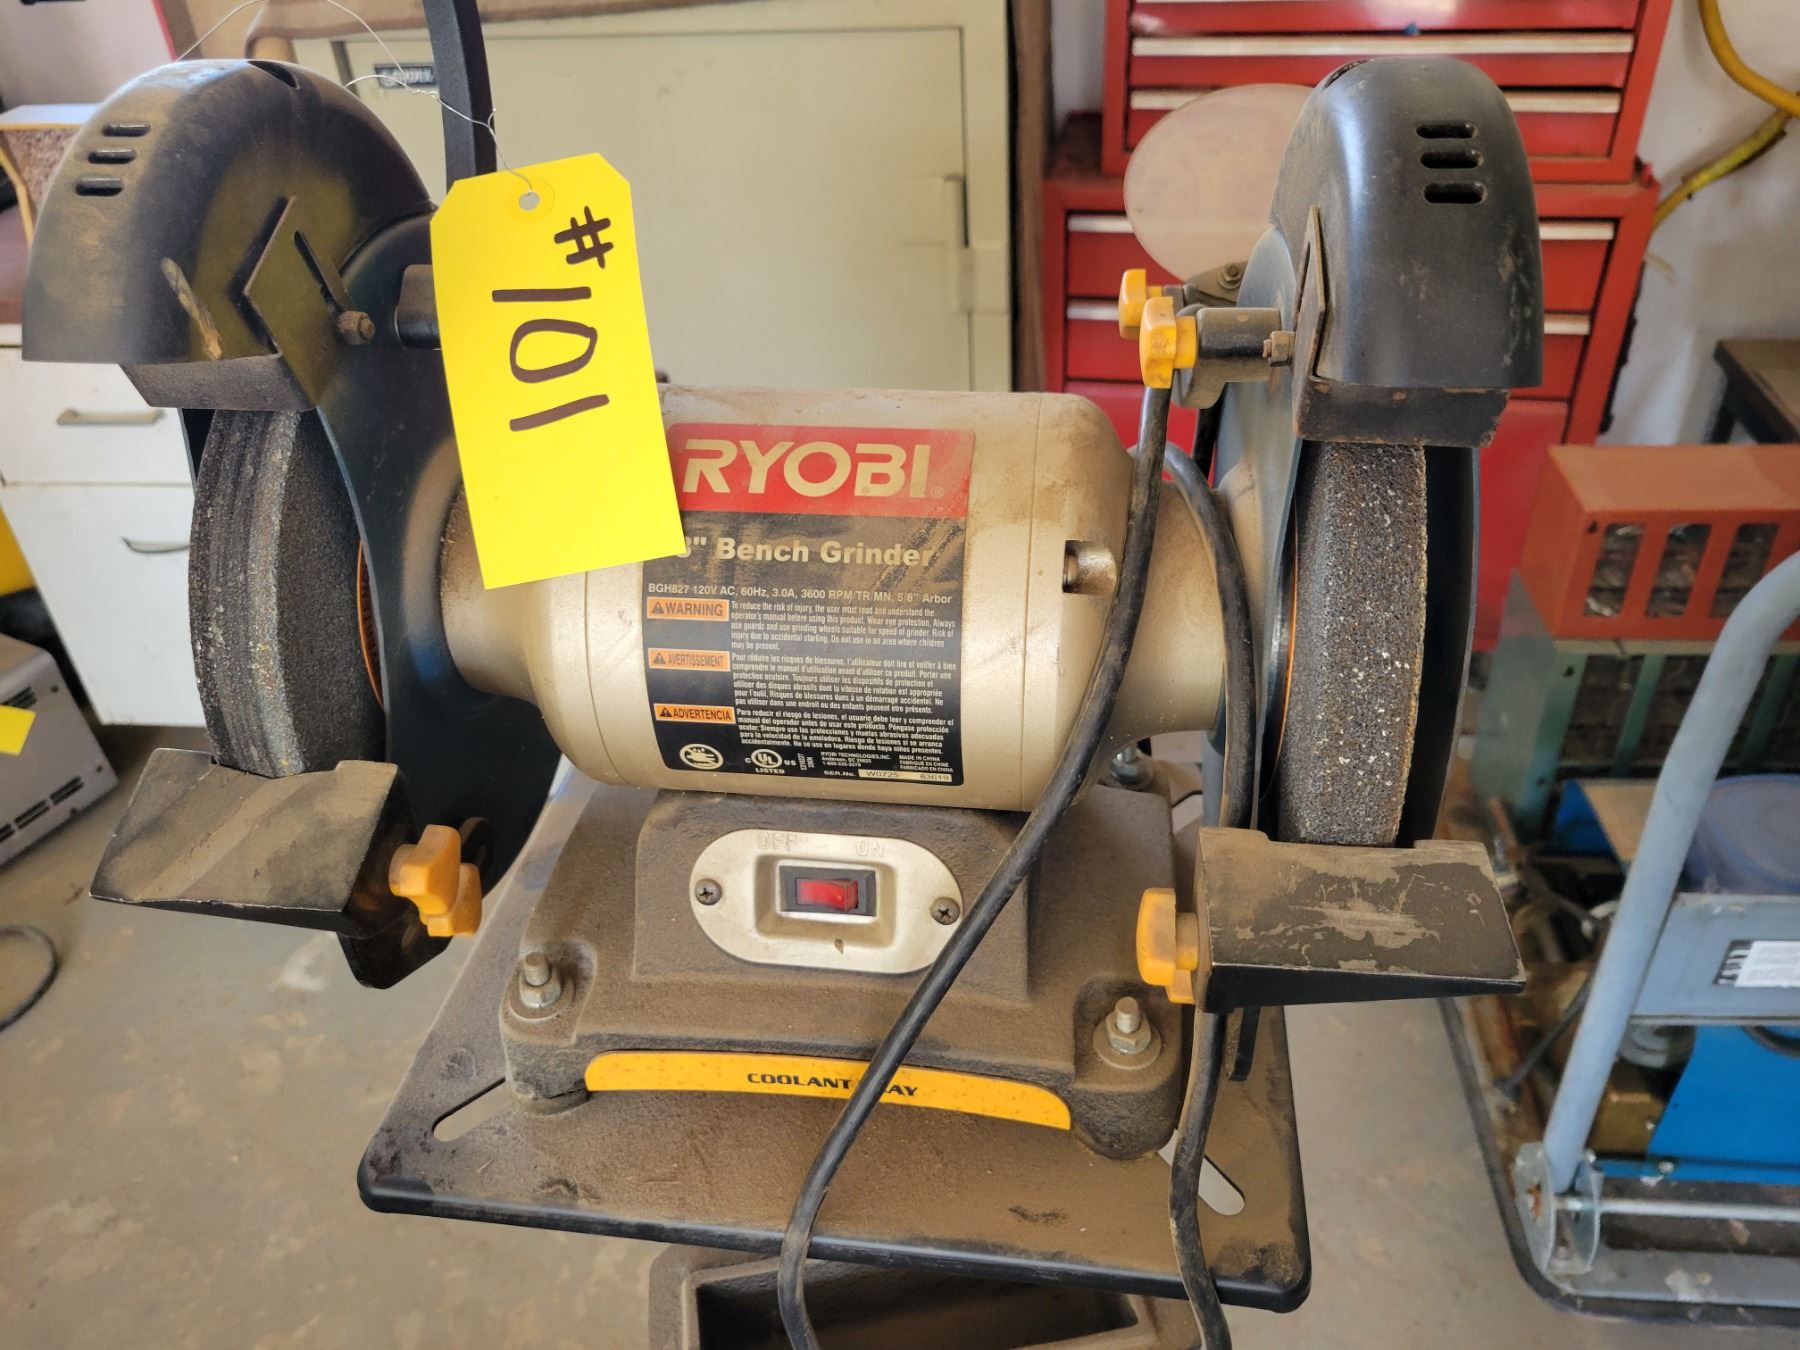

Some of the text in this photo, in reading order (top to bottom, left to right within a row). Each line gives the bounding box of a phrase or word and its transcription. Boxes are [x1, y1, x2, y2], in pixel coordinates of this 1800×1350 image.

[682, 439, 931, 498] RYOBI
[716, 537, 809, 562] Bench
[820, 541, 932, 567] Grinder
[648, 583, 690, 594] BGH827
[693, 585, 718, 595] 120V
[720, 586, 738, 597] AC,
[740, 587, 769, 598] 60Hz,
[772, 588, 798, 599] 3.0A,
[800, 589, 826, 600] 3600
[921, 594, 952, 604] Arbor
[666, 602, 724, 617] WARNING
[668, 654, 724, 667] AVERTISSEMENT
[674, 708, 732, 721] ADVERTENCIA
[757, 831, 885, 858] OFF ON
[747, 1073, 919, 1097] COOLANT AY
